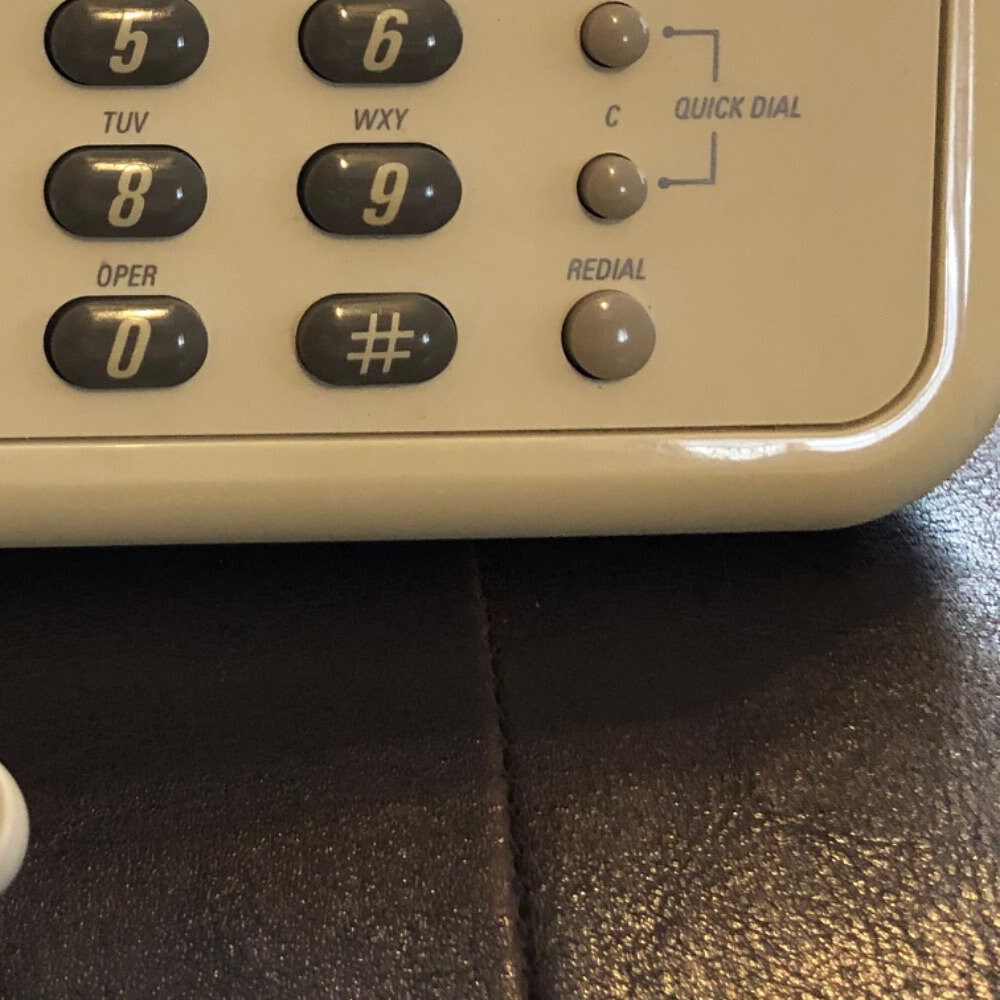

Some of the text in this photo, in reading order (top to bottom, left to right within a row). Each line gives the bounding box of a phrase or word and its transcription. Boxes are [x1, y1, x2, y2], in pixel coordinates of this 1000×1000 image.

[109, 9, 148, 73] 5
[362, 8, 408, 71] 6
[355, 108, 409, 130] WXY
[606, 105, 621, 127] C
[675, 96, 801, 120] QUICK DIAL
[104, 111, 149, 134] TUV
[107, 164, 152, 227] 8
[362, 162, 409, 226] 9
[97, 264, 157, 287] OPER
[567, 258, 645, 281] REDIAL
[106, 316, 152, 378] 0
